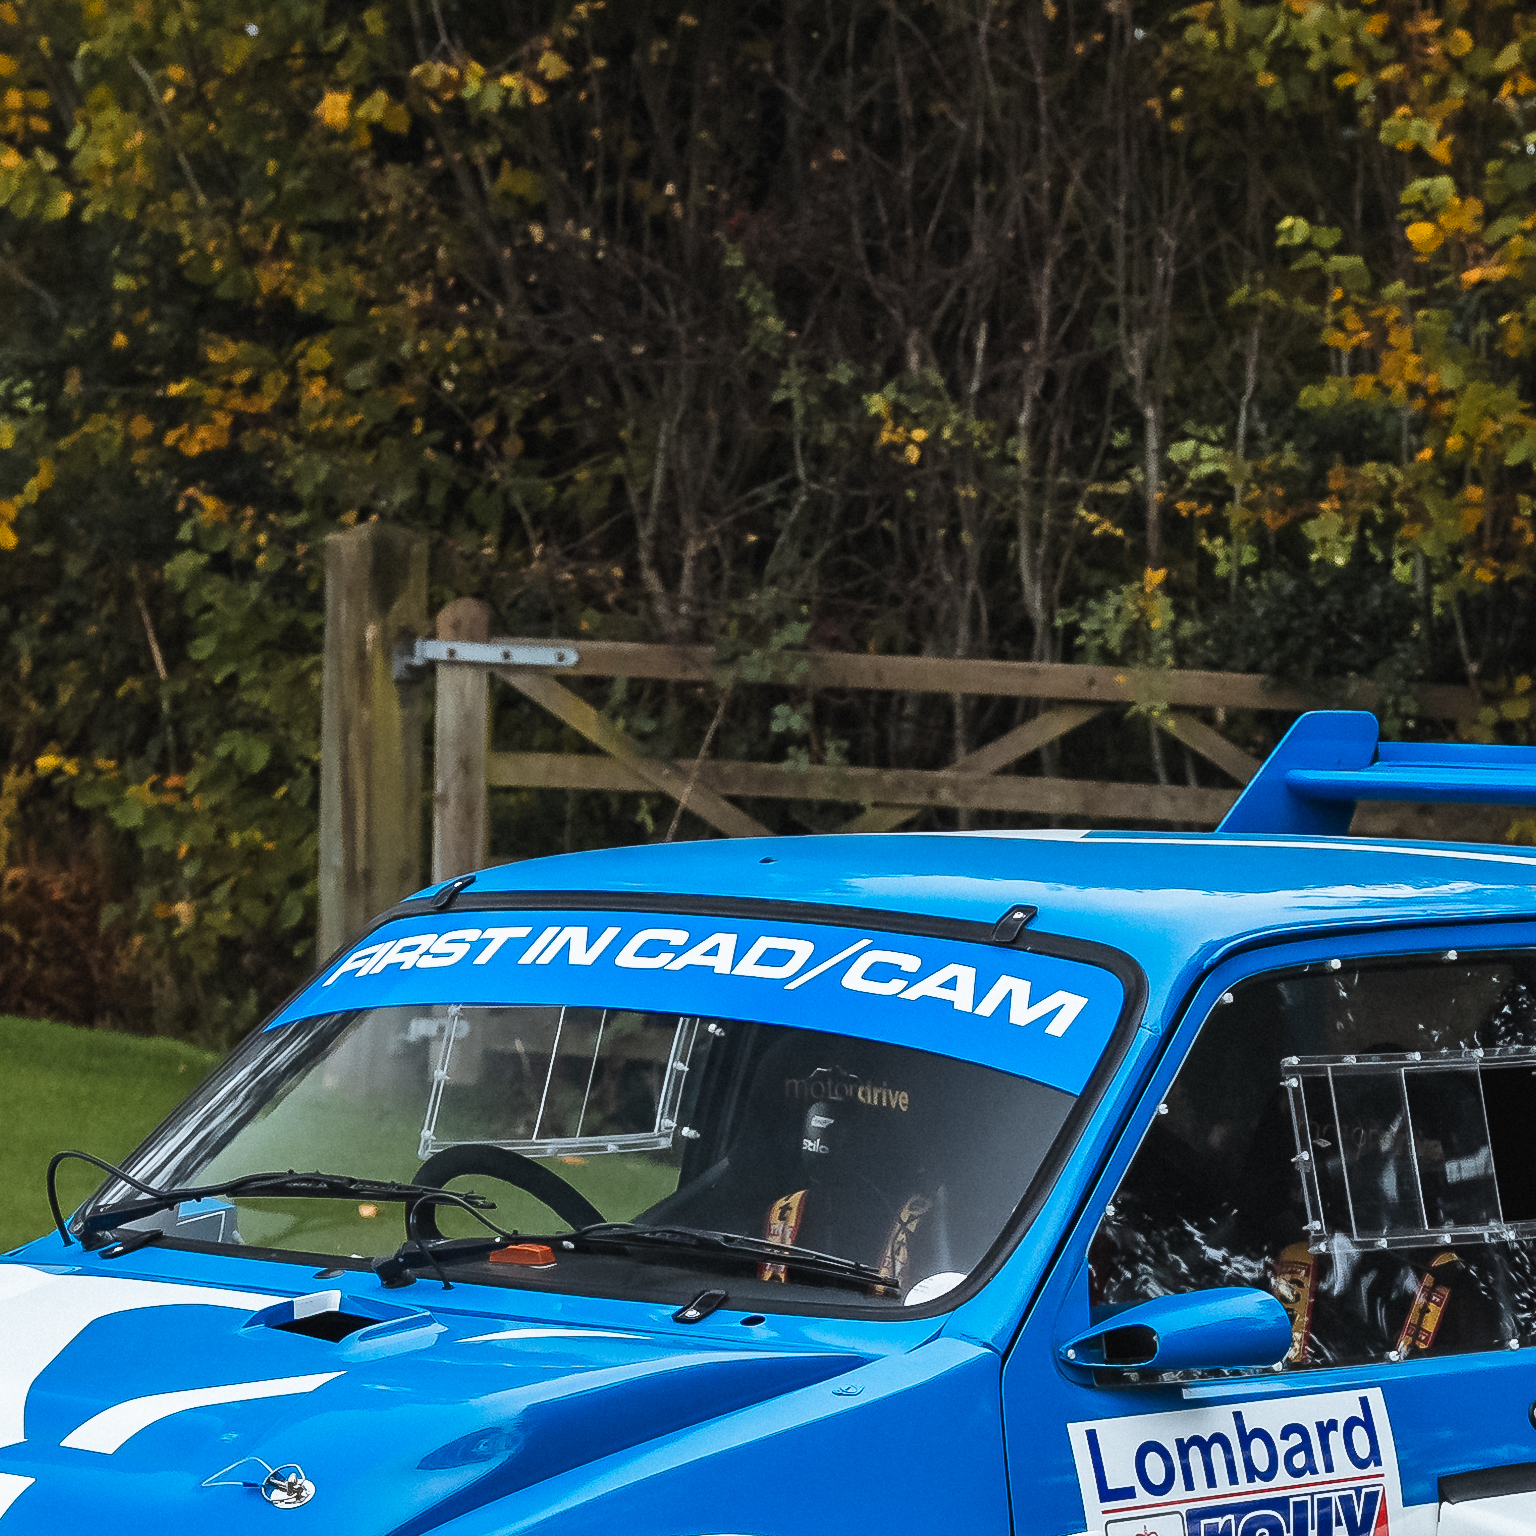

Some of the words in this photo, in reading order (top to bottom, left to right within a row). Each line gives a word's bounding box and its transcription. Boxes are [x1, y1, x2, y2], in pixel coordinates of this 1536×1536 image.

[323, 926, 530, 988] FIRST
[520, 926, 601, 966] IN
[613, 928, 1089, 1039] CAD/CAM
[1085, 1395, 1383, 1503] Lombard
